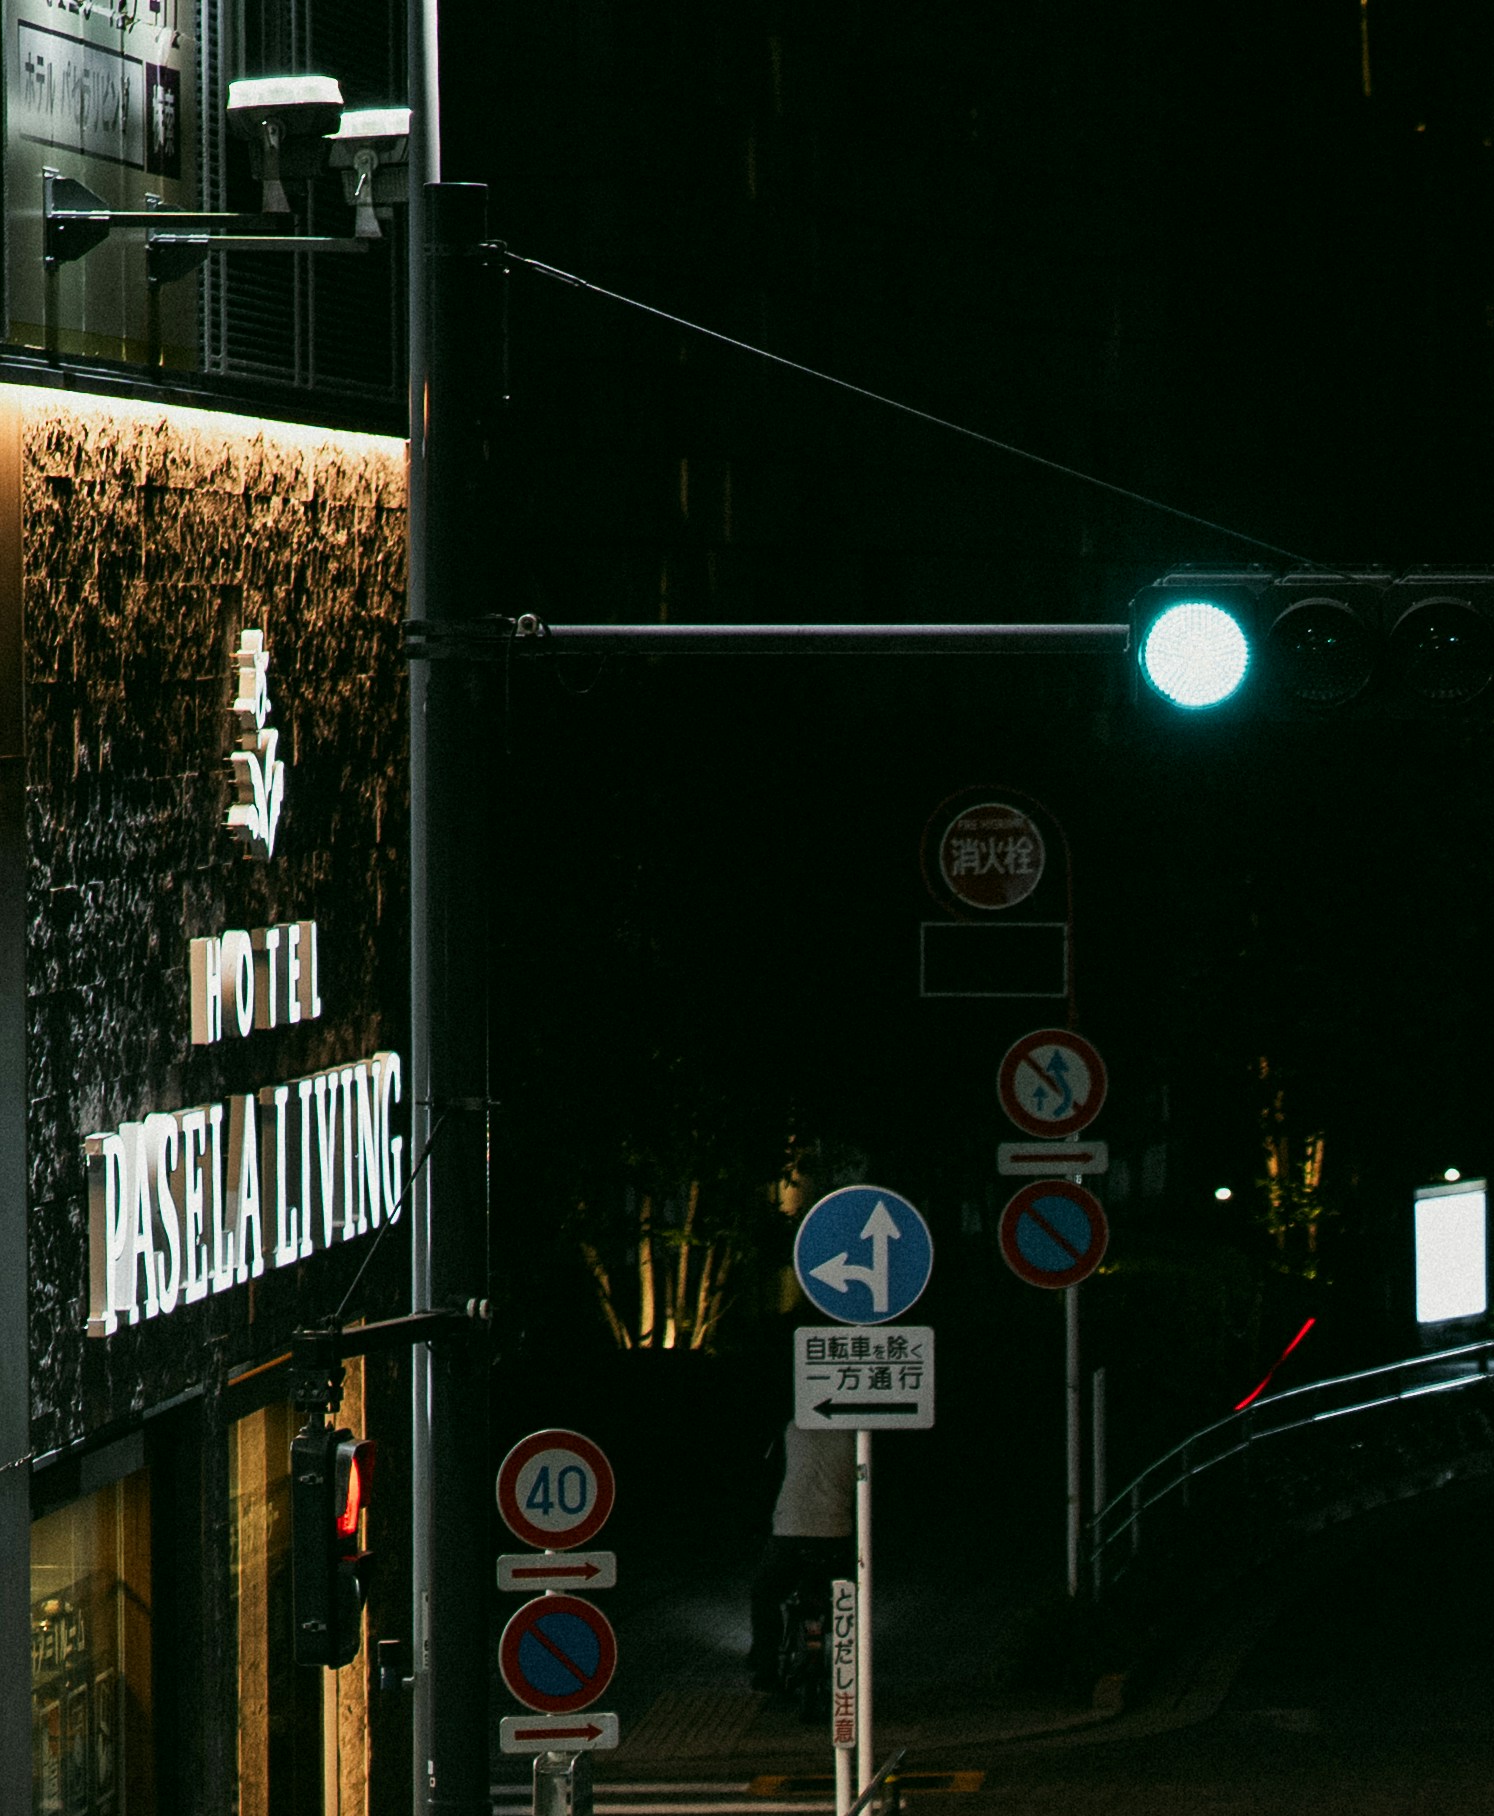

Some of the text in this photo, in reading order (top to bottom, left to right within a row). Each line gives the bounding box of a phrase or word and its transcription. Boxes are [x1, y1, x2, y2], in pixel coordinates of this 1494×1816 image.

[951, 835, 1035, 877] 消火栓
[194, 920, 321, 1044] HOTEL
[90, 1051, 403, 1336] PASELA LIVING
[806, 1335, 923, 1360] 自転車を除く
[806, 1366, 924, 1391] 一方通行
[525, 1465, 587, 1515] 40
[834, 1587, 854, 1744] とびだし注意
